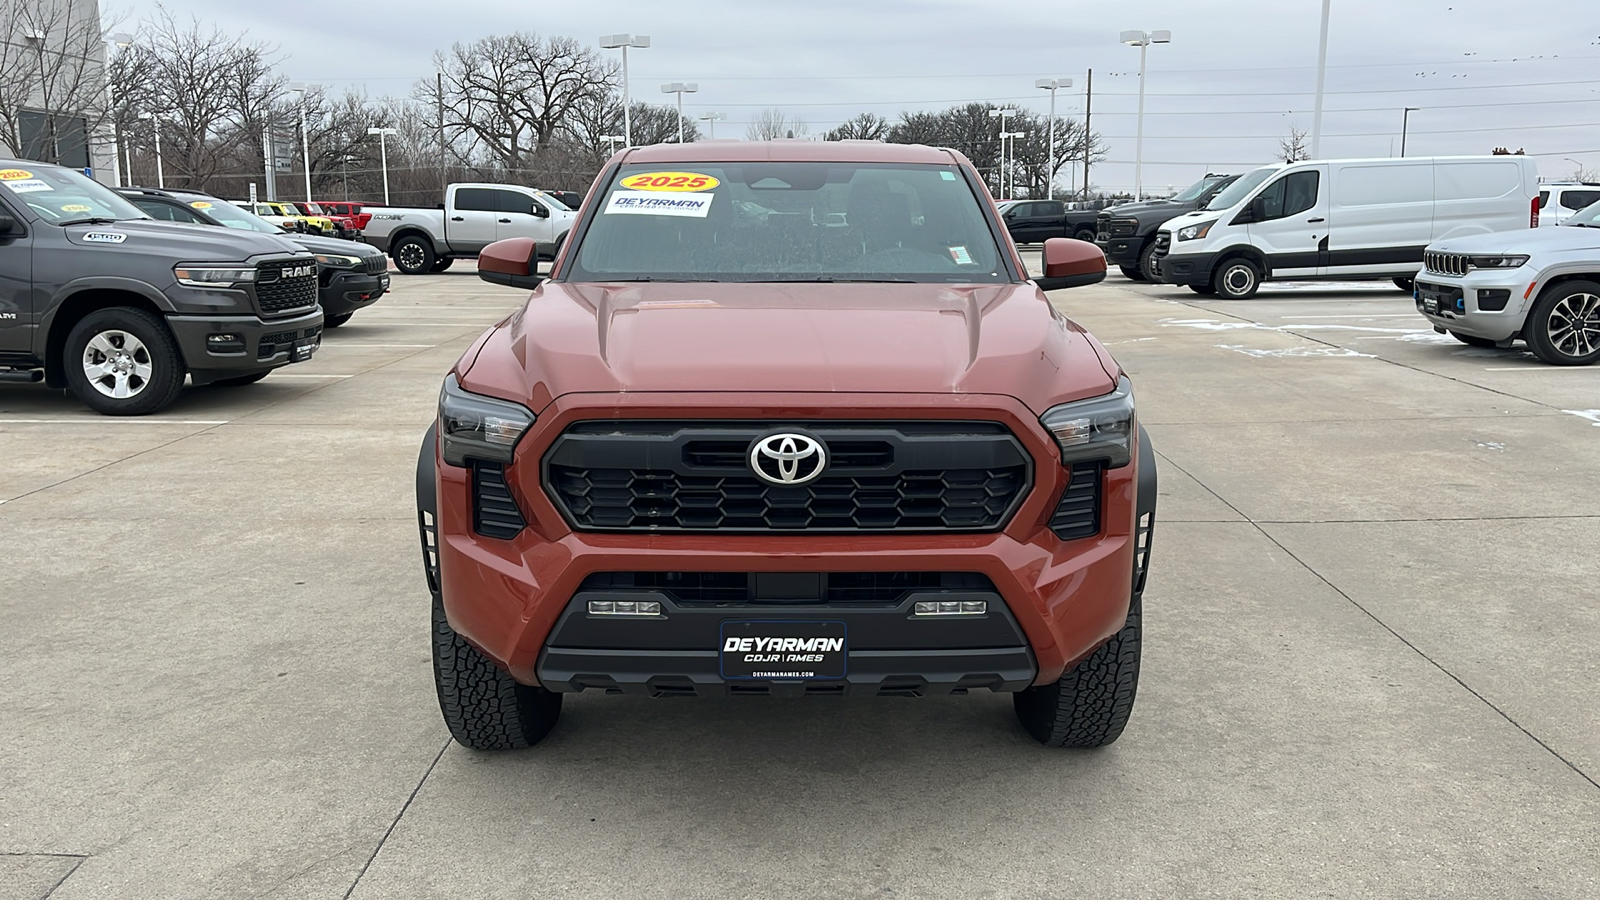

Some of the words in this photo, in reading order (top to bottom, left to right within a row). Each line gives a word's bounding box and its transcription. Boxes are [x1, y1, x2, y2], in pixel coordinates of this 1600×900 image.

[0, 170, 28, 179] 2025
[630, 176, 709, 188] 2025
[615, 197, 705, 208] DEYARMAN
[281, 265, 311, 279] RAM
[723, 637, 844, 652] DEYARMAN
[743, 654, 780, 662] CDJR
[786, 654, 825, 662] AMES
